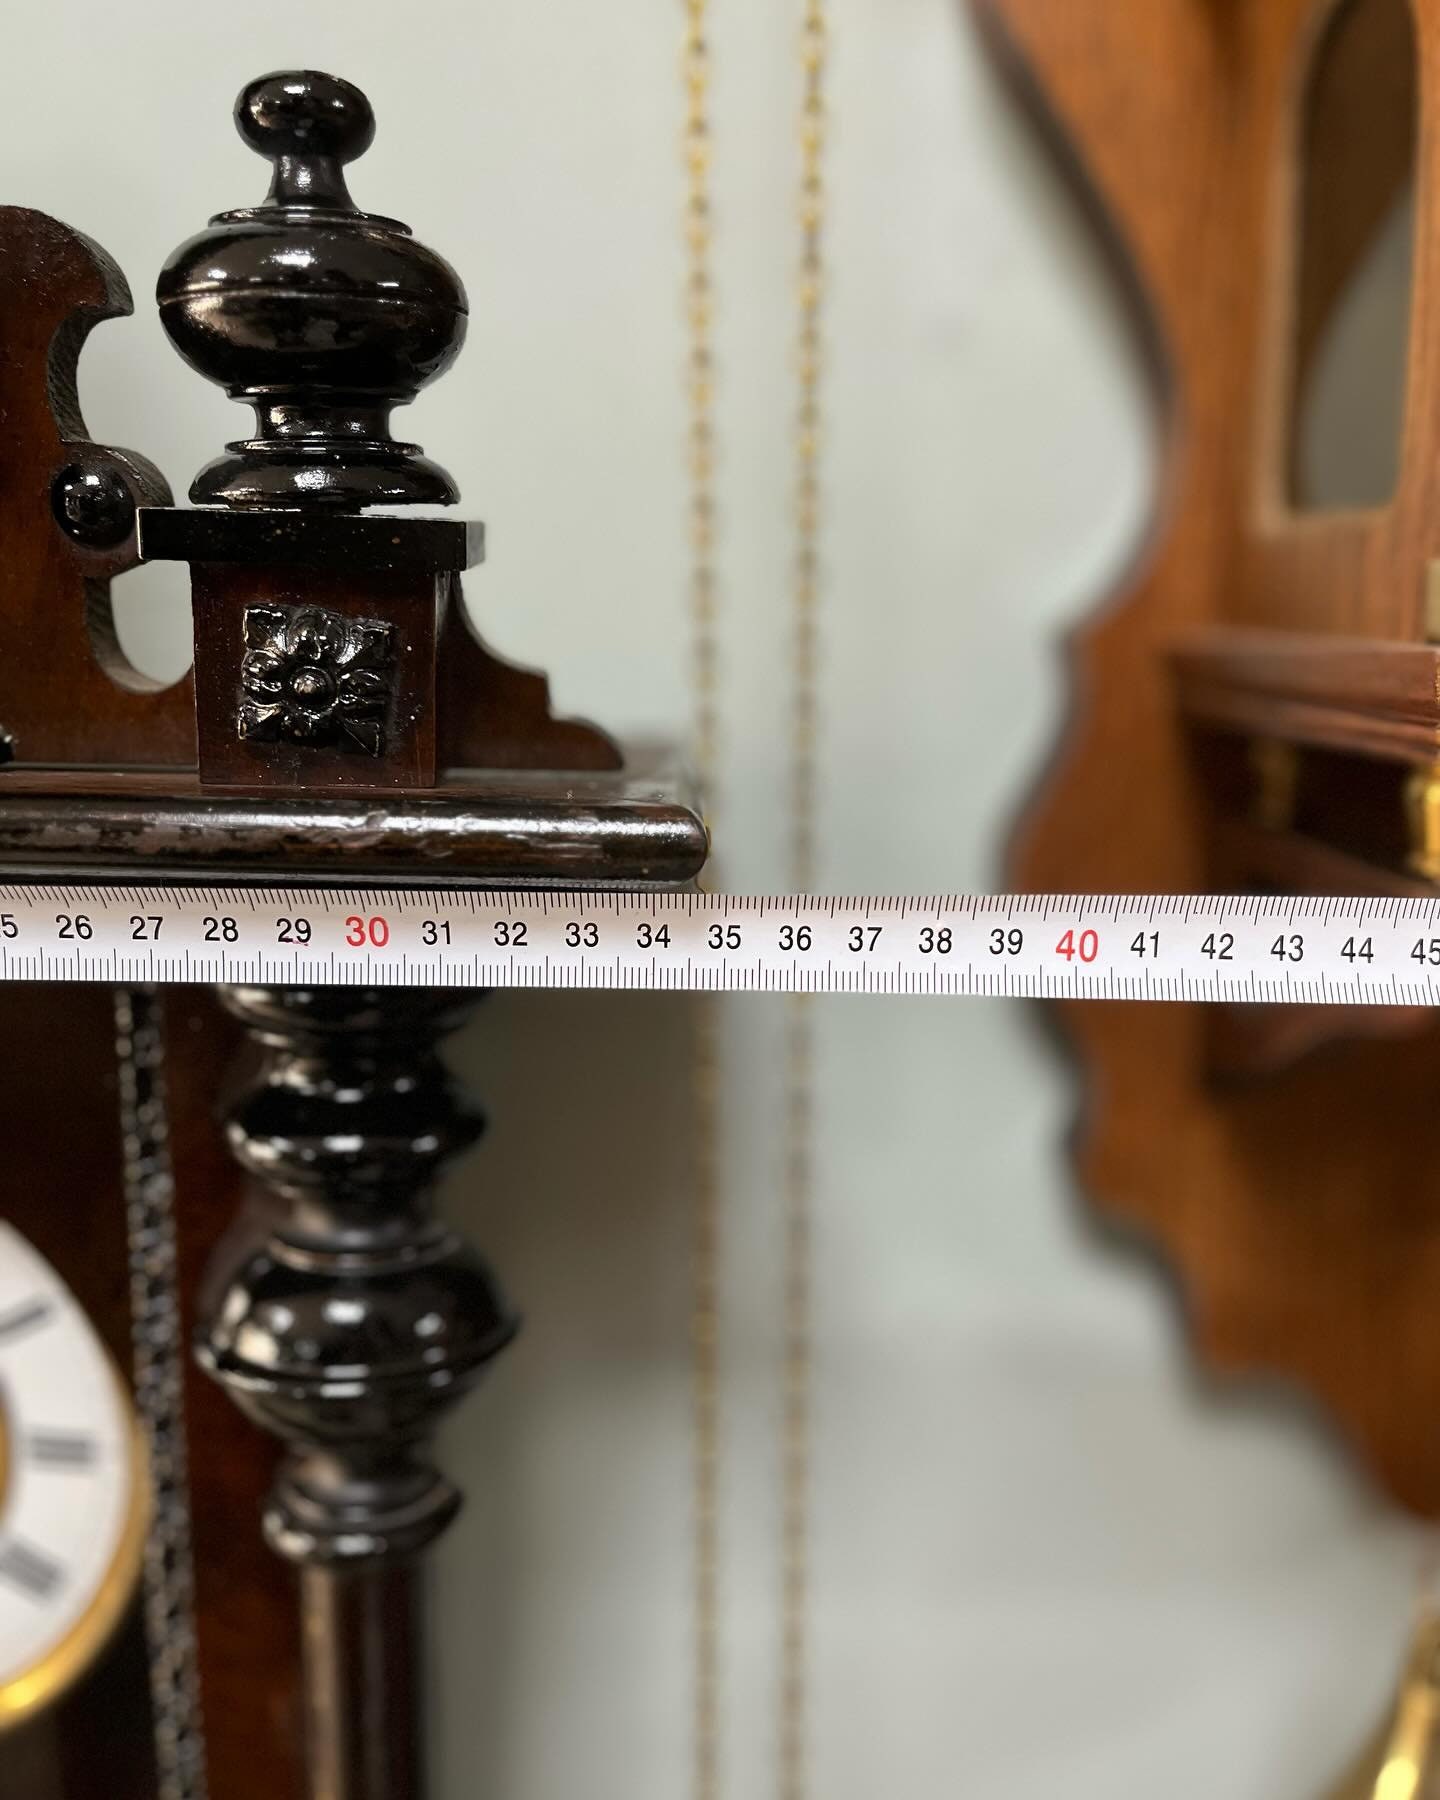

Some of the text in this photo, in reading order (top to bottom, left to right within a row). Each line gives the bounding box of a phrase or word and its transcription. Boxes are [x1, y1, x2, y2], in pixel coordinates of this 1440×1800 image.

[0, 914, 1440, 965] 5 26 27 28 29 30 31 32 33 34 35 36 37 38 39 40 41 42 43 44 45
